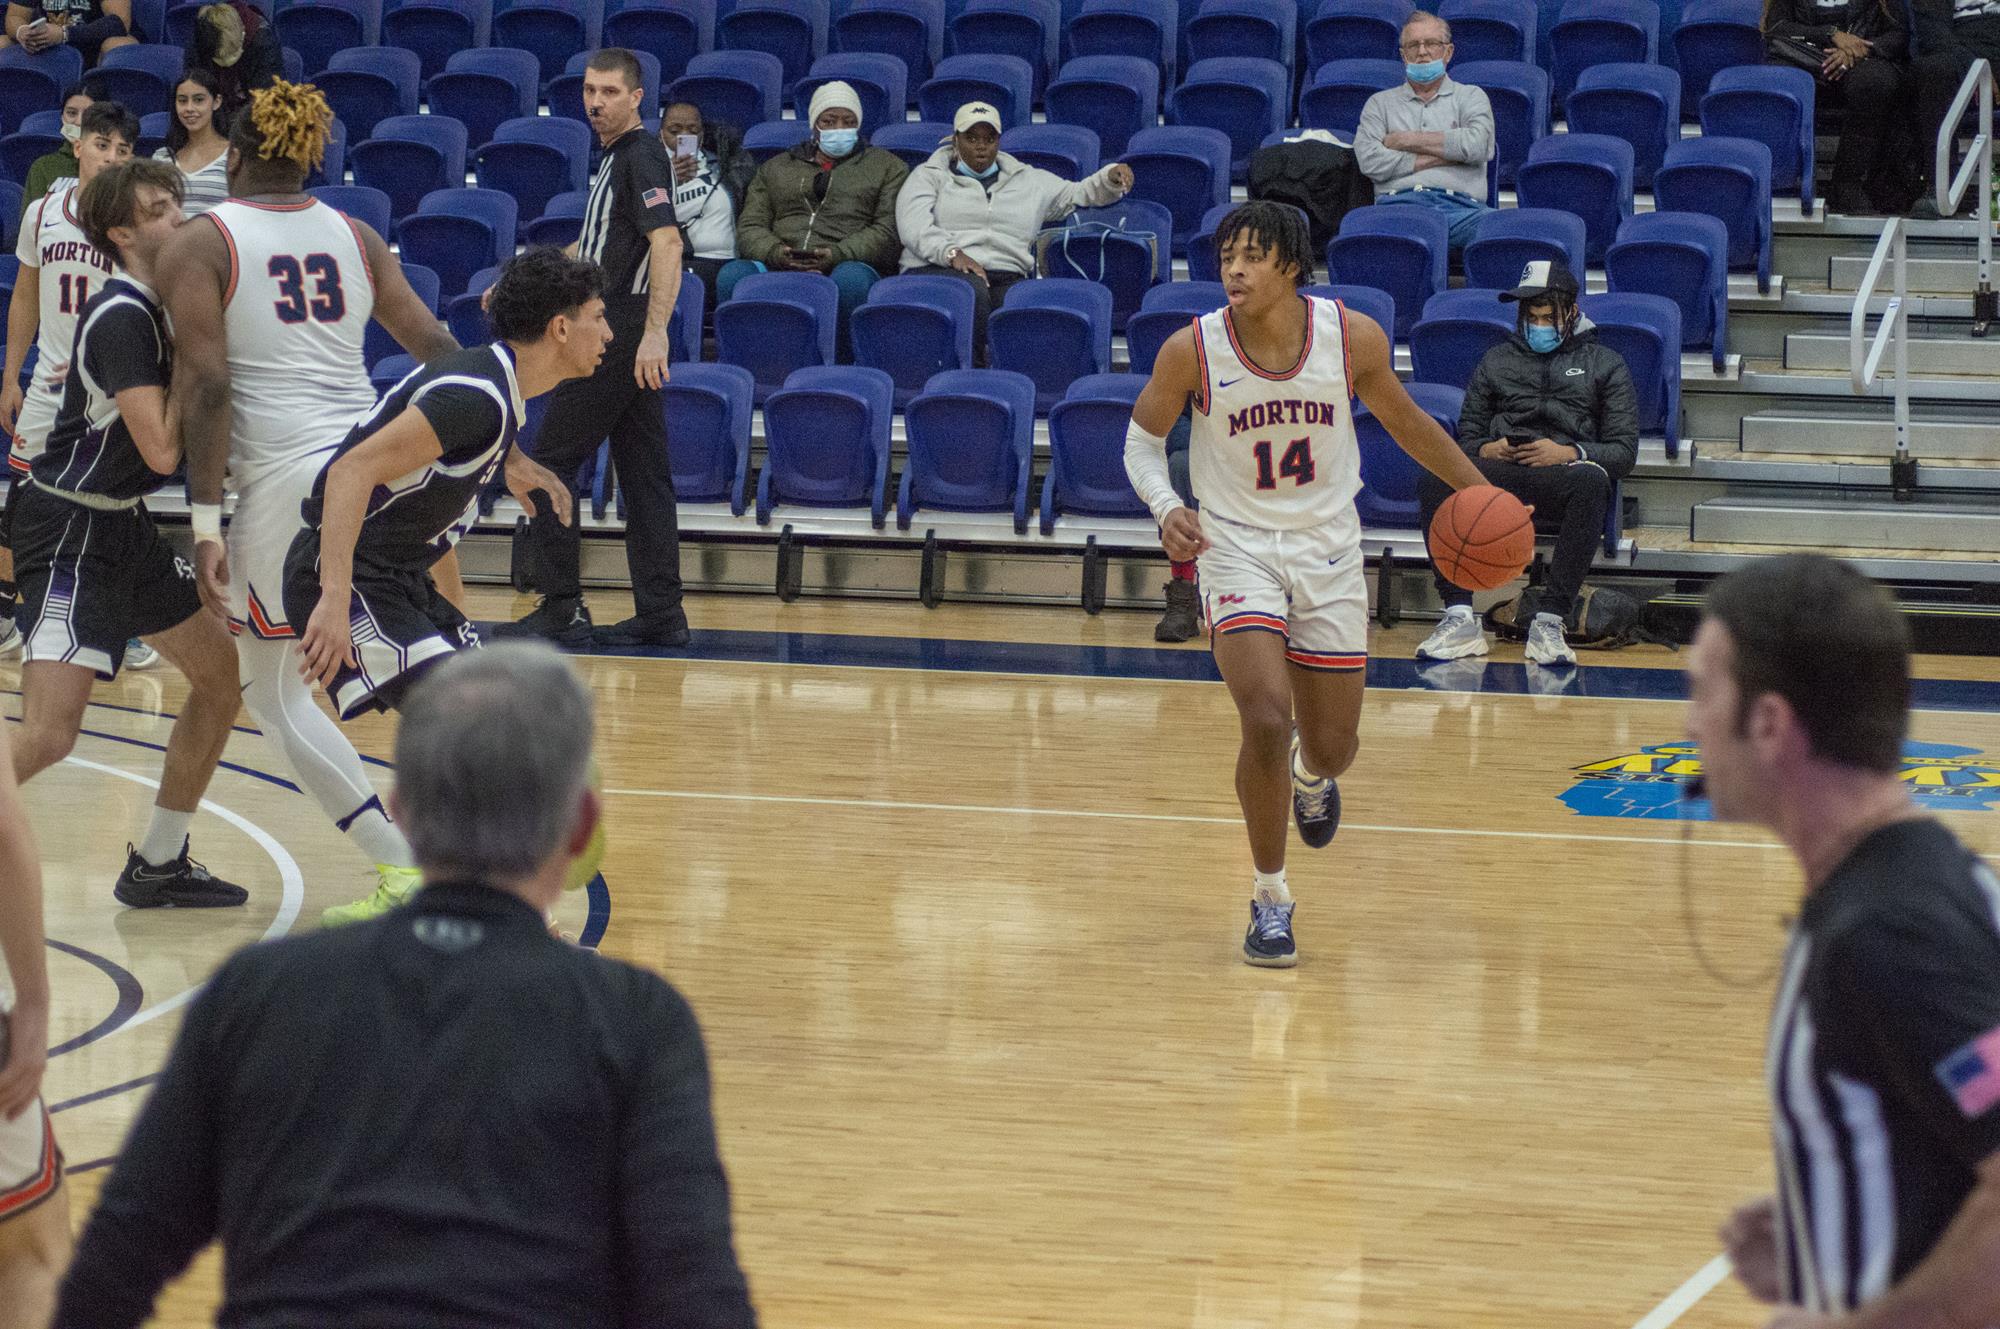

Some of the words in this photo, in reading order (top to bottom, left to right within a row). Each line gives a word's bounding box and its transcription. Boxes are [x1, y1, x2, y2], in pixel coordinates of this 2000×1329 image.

[59, 273, 88, 314] 11
[267, 252, 346, 325] 33
[1227, 399, 1335, 437] MORTON
[1253, 436, 1315, 490] 14
